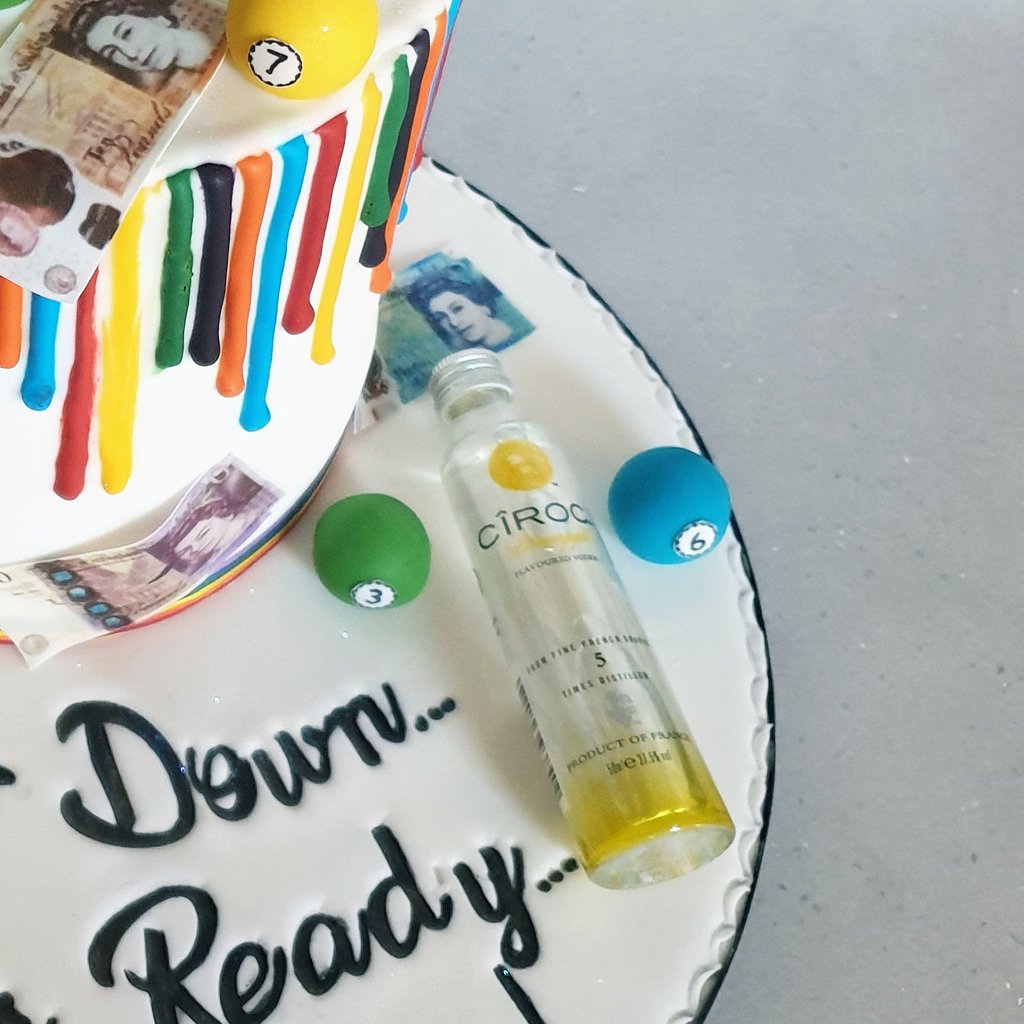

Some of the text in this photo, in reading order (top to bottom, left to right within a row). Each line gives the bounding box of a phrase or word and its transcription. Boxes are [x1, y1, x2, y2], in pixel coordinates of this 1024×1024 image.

[265, 50, 285, 78] 7
[691, 534, 706, 552] 6
[368, 589, 383, 604] 3
[594, 651, 607, 668] 5
[561, 681, 594, 699] TIMES
[566, 739, 625, 773] PRODUCT
[628, 732, 649, 744] OF
